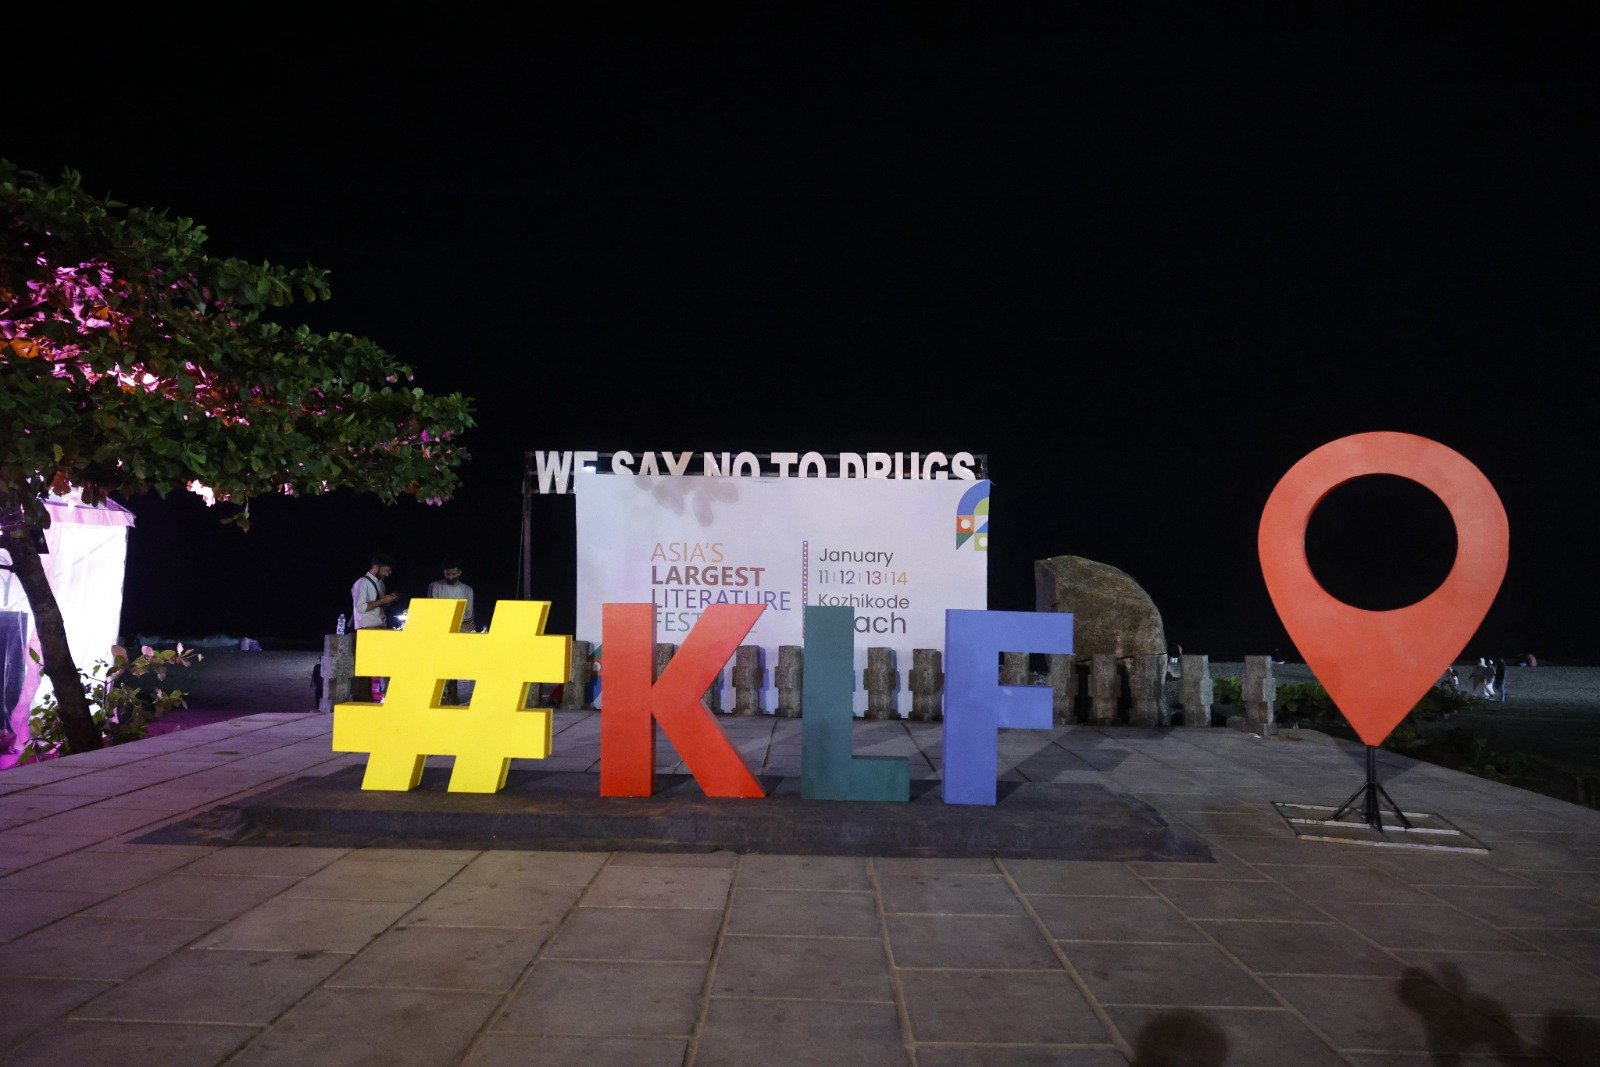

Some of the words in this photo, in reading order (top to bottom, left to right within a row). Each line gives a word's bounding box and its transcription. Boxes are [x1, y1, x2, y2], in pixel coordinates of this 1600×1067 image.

[535, 450, 598, 494] WE
[611, 450, 694, 476] SAY
[704, 451, 760, 477] NO
[771, 451, 827, 478] TO
[839, 451, 976, 480] DRUGS
[819, 548, 894, 568] January
[651, 565, 766, 587] LARGEST
[818, 569, 829, 584] 11
[840, 570, 855, 585] 12
[866, 570, 882, 585] 13
[890, 571, 908, 586] 14
[651, 588, 792, 611] LITERATURE
[818, 593, 910, 609] Kozhikode
[854, 611, 907, 634] ach
